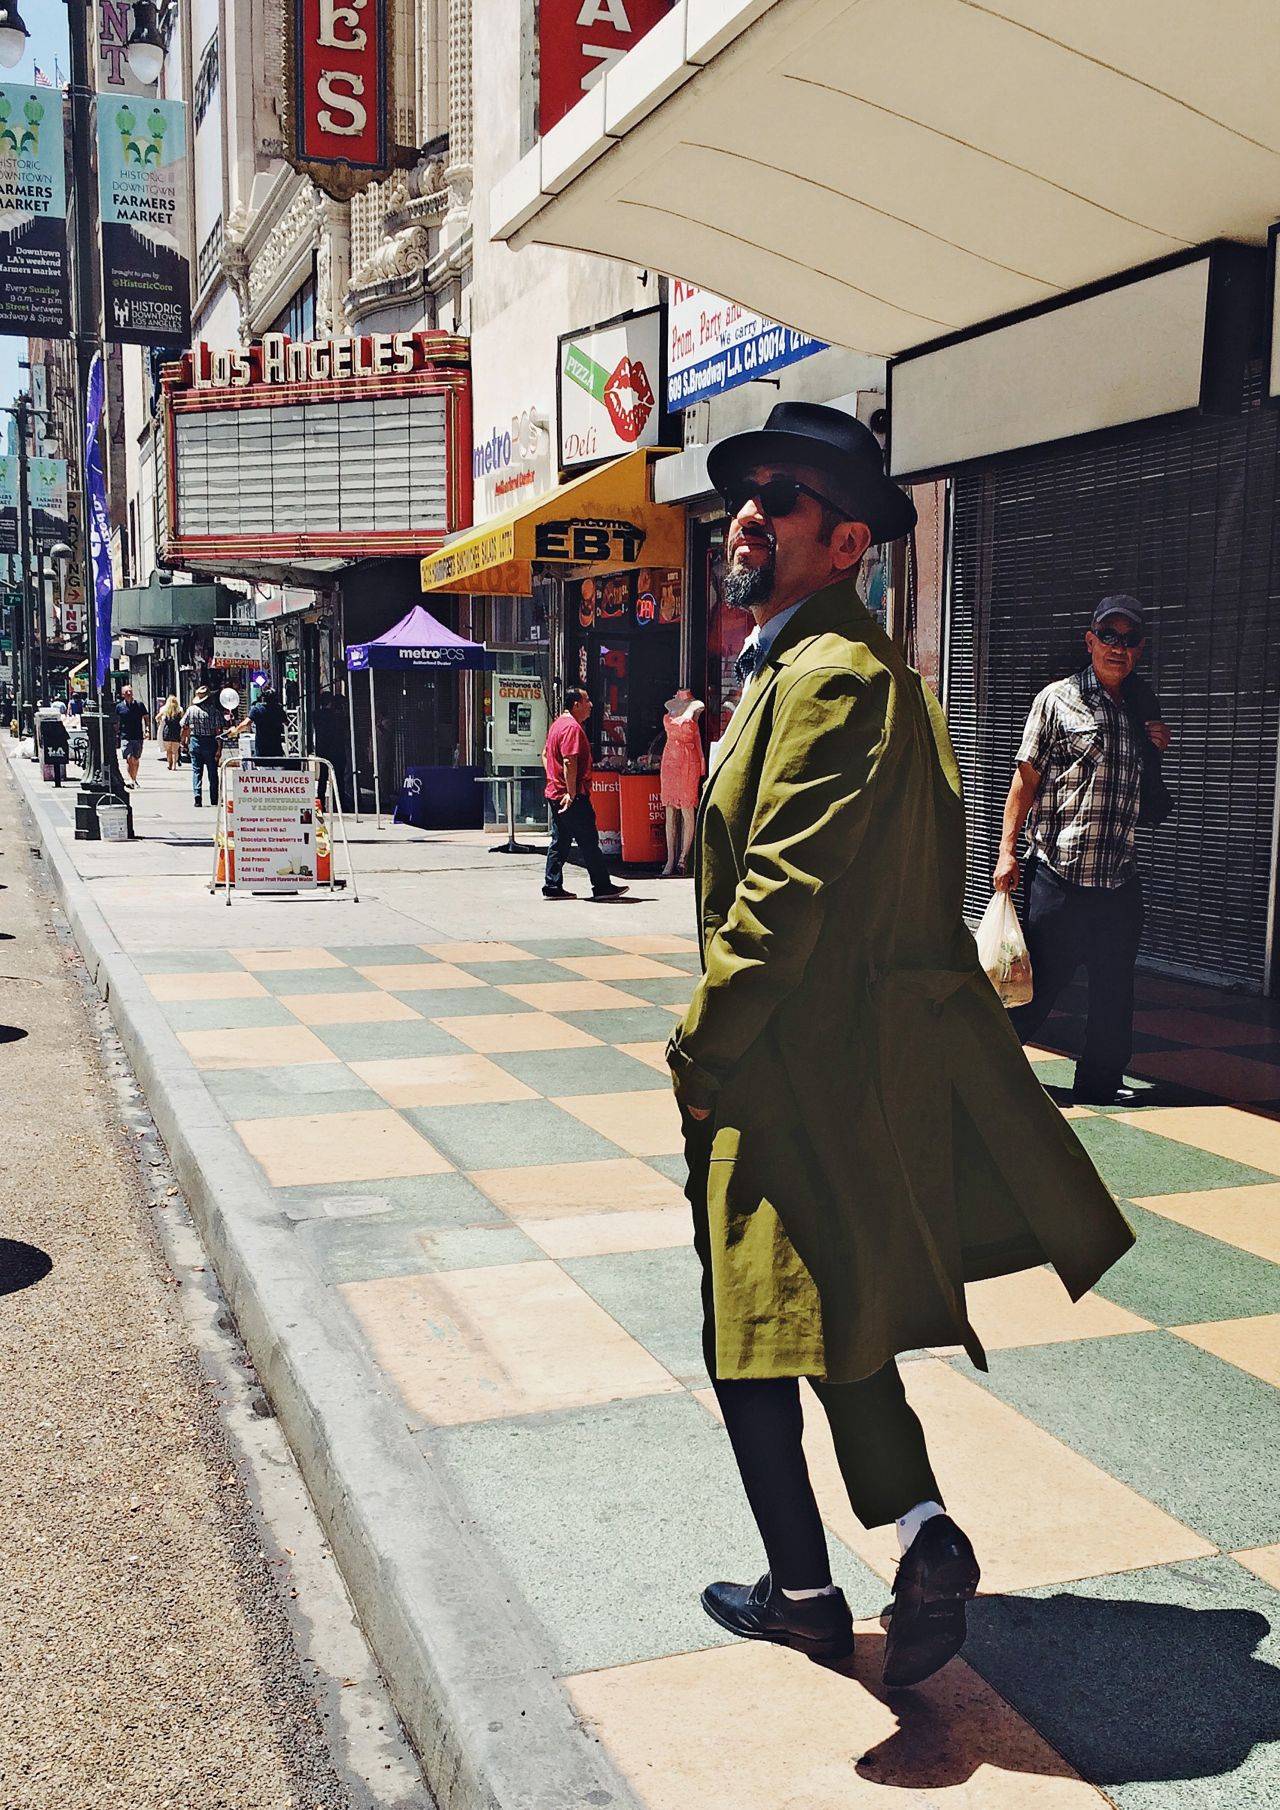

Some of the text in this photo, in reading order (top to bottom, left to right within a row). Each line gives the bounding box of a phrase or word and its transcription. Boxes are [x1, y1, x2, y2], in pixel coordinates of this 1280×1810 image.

[0, 184, 53, 198] ARMERS
[112, 181, 175, 196] DOWNTOWN
[0, 198, 50, 212] ARKET
[113, 194, 175, 211] FARMERS
[117, 209, 173, 224] MARKET
[16, 247, 61, 257] Downtown
[26, 257, 61, 267] weekend
[32, 267, 62, 276] market
[5, 284, 60, 296] Every Sunday
[6, 303, 30, 312] Street
[31, 304, 63, 314] between
[131, 300, 182, 315] HISTORIC
[37, 314, 64, 325] Spring
[131, 310, 182, 321] DOWNTOWN
[148, 320, 182, 329] ANGELES
[700, 308, 723, 346] Party
[720, 332, 732, 348] We
[735, 320, 757, 341] carry
[672, 326, 695, 363] Prom,
[668, 374, 683, 403] 609
[744, 340, 758, 371] CA
[758, 327, 786, 365] 90014
[566, 355, 594, 390] PIZZA
[564, 425, 597, 459] Deli
[67, 501, 80, 588] PARKING
[536, 523, 647, 563] EBT
[400, 648, 465, 661] metroPCS
[499, 688, 542, 699] GRATIS
[239, 776, 310, 784] NATURAL JUICES
[252, 786, 306, 794] MILKSHAKES
